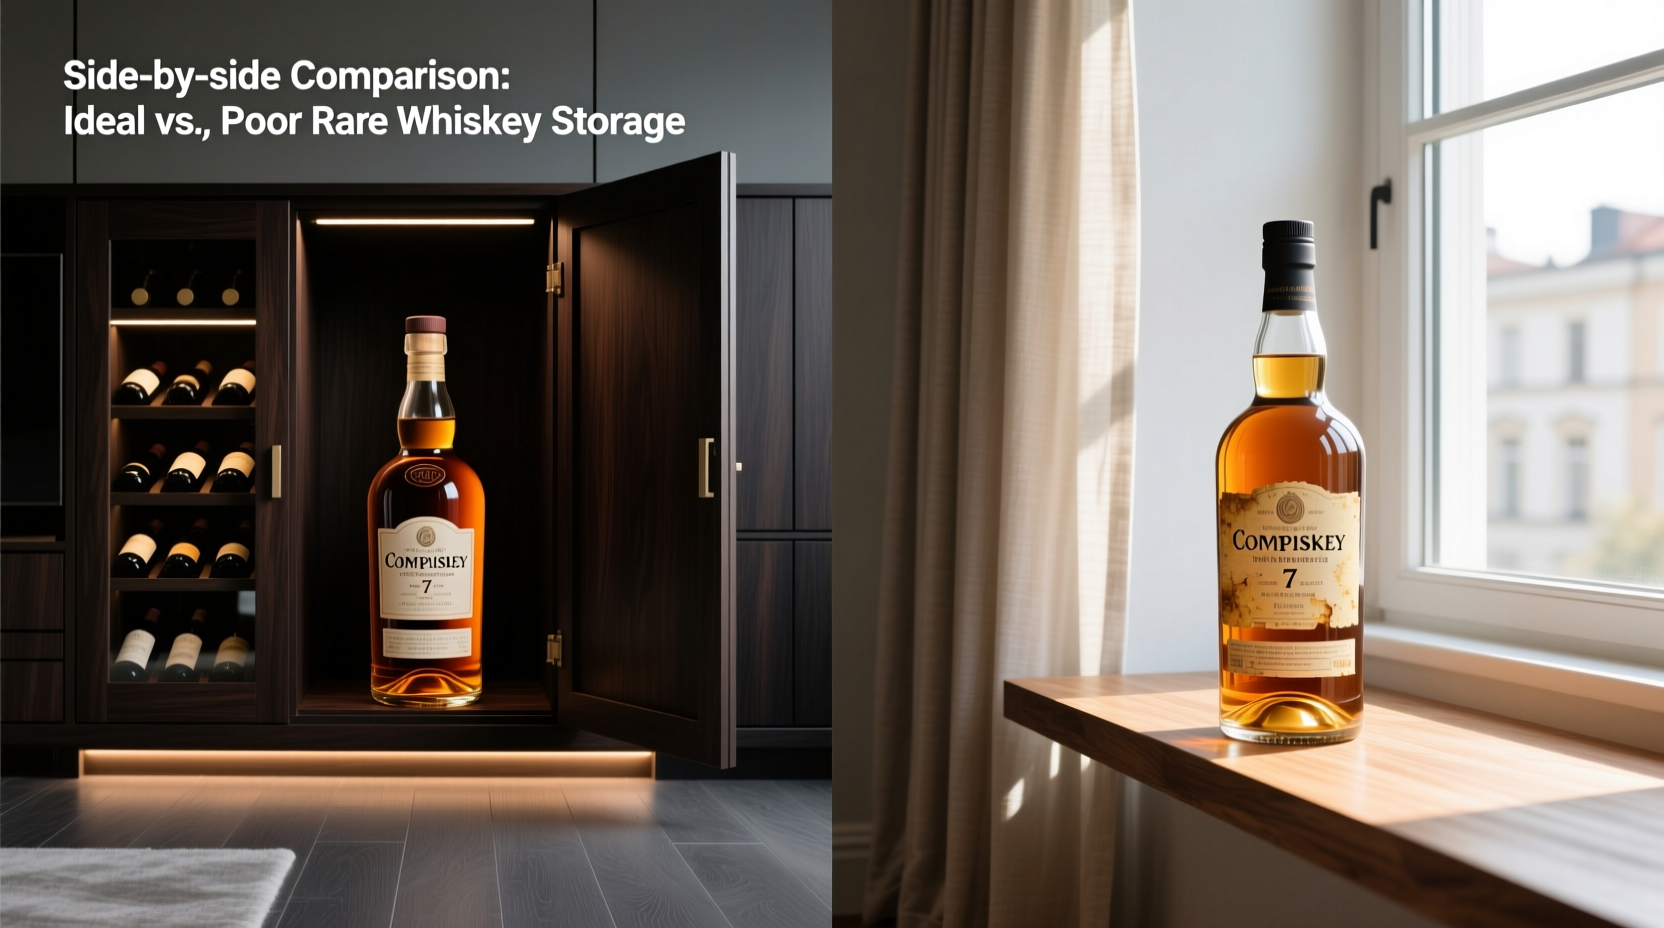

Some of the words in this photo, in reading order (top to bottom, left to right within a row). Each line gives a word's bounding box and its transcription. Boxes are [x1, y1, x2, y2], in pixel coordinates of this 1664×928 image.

[1232, 528, 1346, 552] COMPISKEY
[421, 579, 432, 594] 7
[1282, 568, 1298, 589] 7
